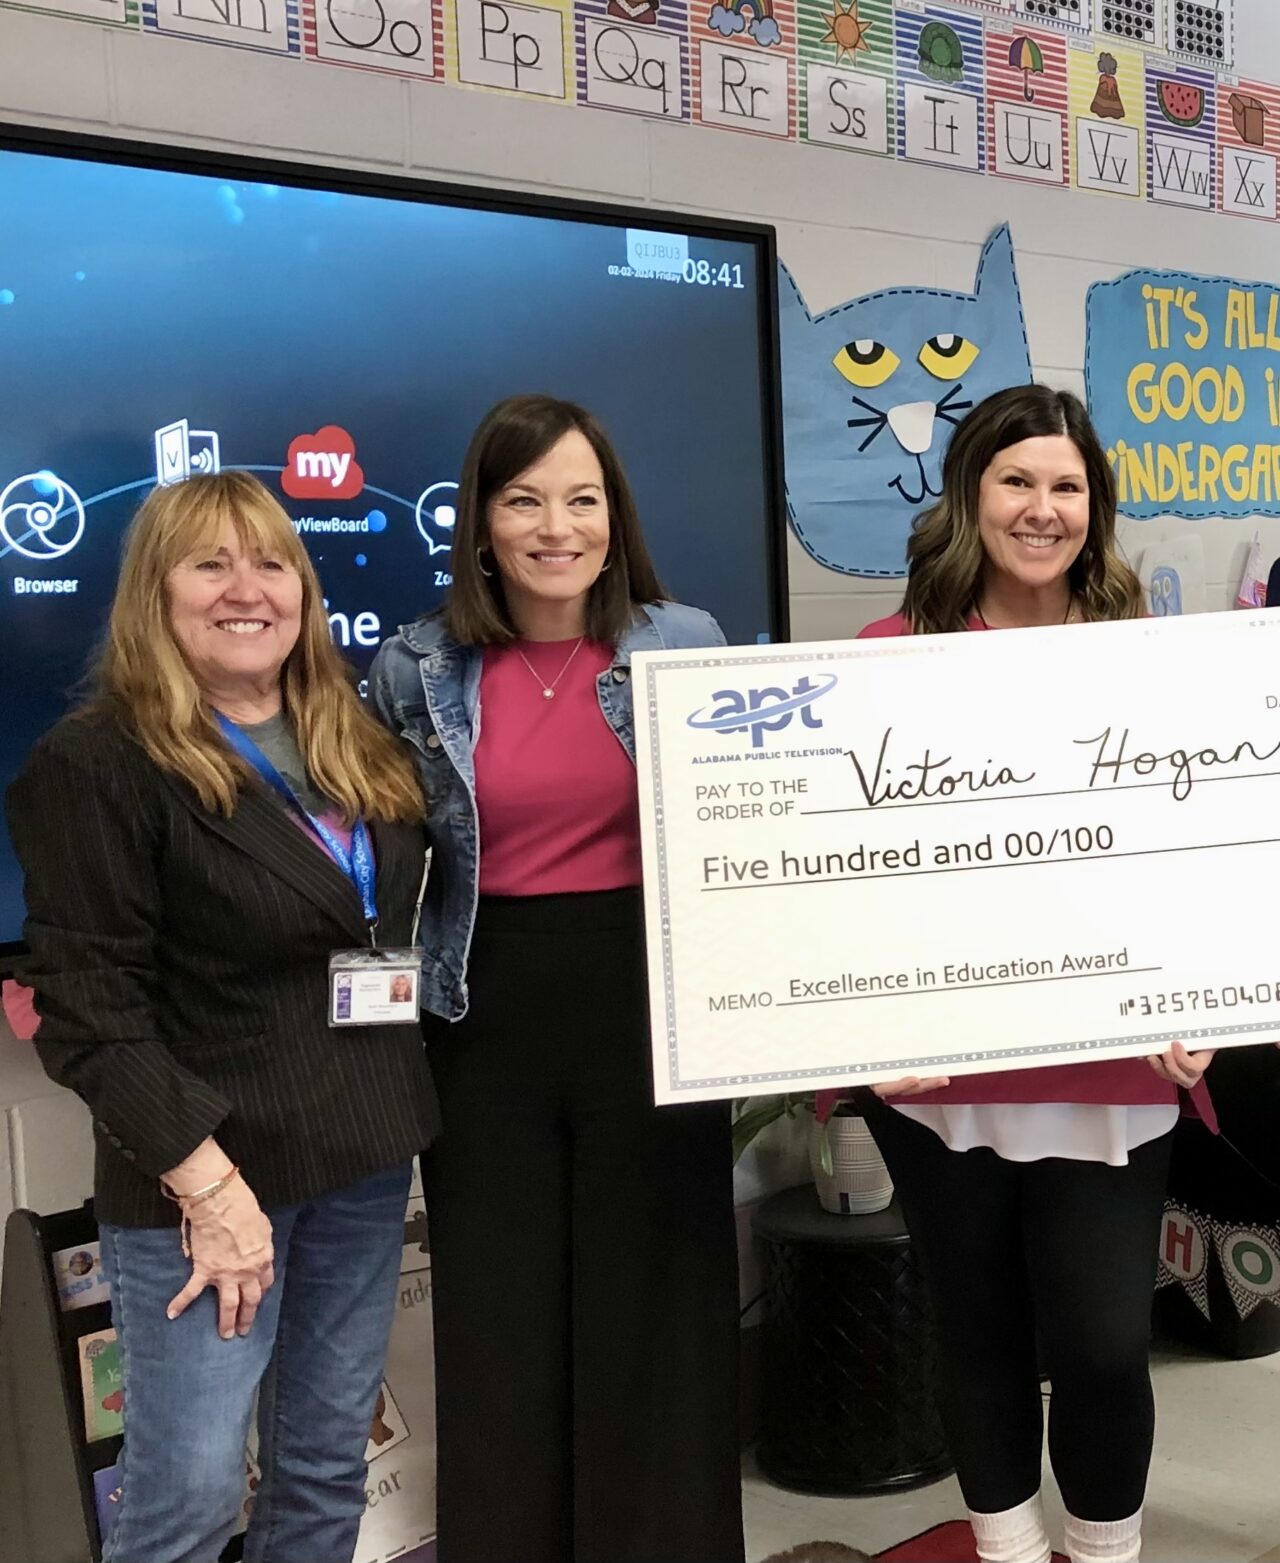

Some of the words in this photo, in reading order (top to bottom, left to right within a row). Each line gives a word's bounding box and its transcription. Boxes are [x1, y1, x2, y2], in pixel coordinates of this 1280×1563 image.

[327, 0, 423, 56] Oo
[481, 2, 541, 88] Pp
[595, 27, 670, 114] Qq
[721, 56, 770, 118] Rr
[829, 79, 867, 138] Ss
[924, 95, 959, 154] Tt
[1005, 112, 1051, 170] Uu
[1088, 129, 1128, 184] Vv
[1154, 144, 1209, 197] Ww
[1234, 156, 1265, 208] Xx
[655, 270, 682, 284] Friday
[682, 258, 745, 289] 08:41
[1127, 361, 1246, 424] GOOD
[297, 451, 351, 488] my
[14, 577, 79, 595] Browser
[710, 675, 823, 749] apt
[691, 753, 742, 765] ALABAMA
[744, 751, 781, 761] PUBLIC
[784, 747, 844, 758] TELEVISION
[843, 726, 1036, 807] Victoria
[695, 783, 731, 800] PAY
[736, 781, 764, 797] TO
[769, 778, 809, 795] THE
[696, 802, 764, 822] ORDER
[769, 800, 795, 816] OF
[702, 856, 769, 884] Five
[781, 839, 921, 877] hundred
[933, 833, 993, 866] and
[1004, 824, 1115, 859] 00/100
[707, 991, 773, 1012] MEMO
[788, 970, 909, 1000] Excellence
[916, 966, 936, 987] in
[943, 956, 1054, 983] Education
[1060, 947, 1129, 973] Award
